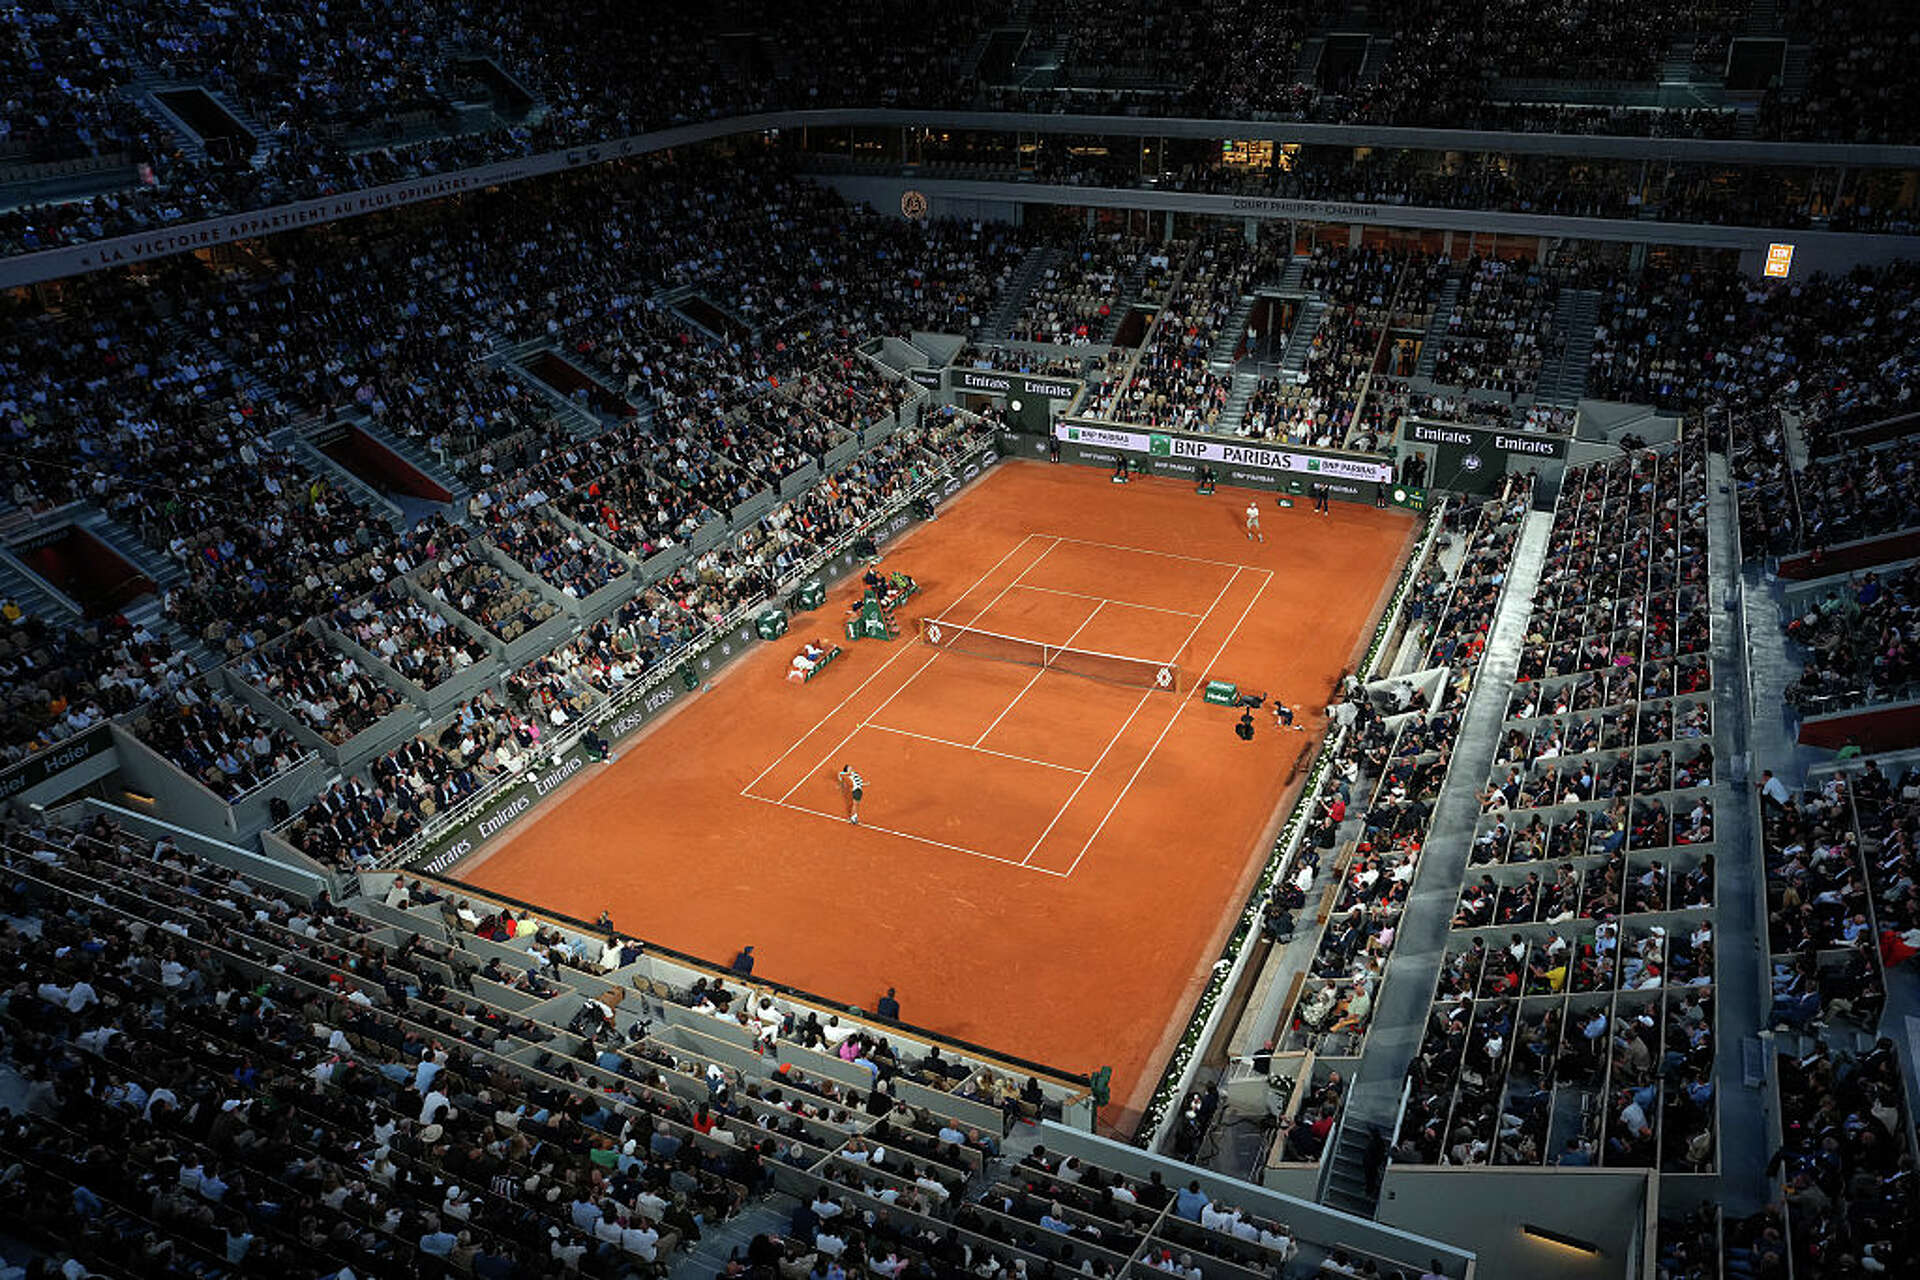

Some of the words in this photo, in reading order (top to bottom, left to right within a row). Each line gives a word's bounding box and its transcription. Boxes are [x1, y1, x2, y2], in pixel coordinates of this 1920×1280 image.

[1232, 199, 1267, 210] COURT
[99, 250, 123, 263] LA
[132, 230, 220, 255] VICTOIRE
[964, 374, 1011, 391] Emirates
[1024, 381, 1072, 397] Emirates
[1414, 426, 1472, 445] Emirates
[1495, 436, 1554, 455] Emirates
[1175, 440, 1207, 457] BNP
[1223, 447, 1291, 469] PARIBAS
[535, 754, 583, 796] Emirates
[478, 794, 530, 839] Emirates
[423, 838, 471, 874] mirates
